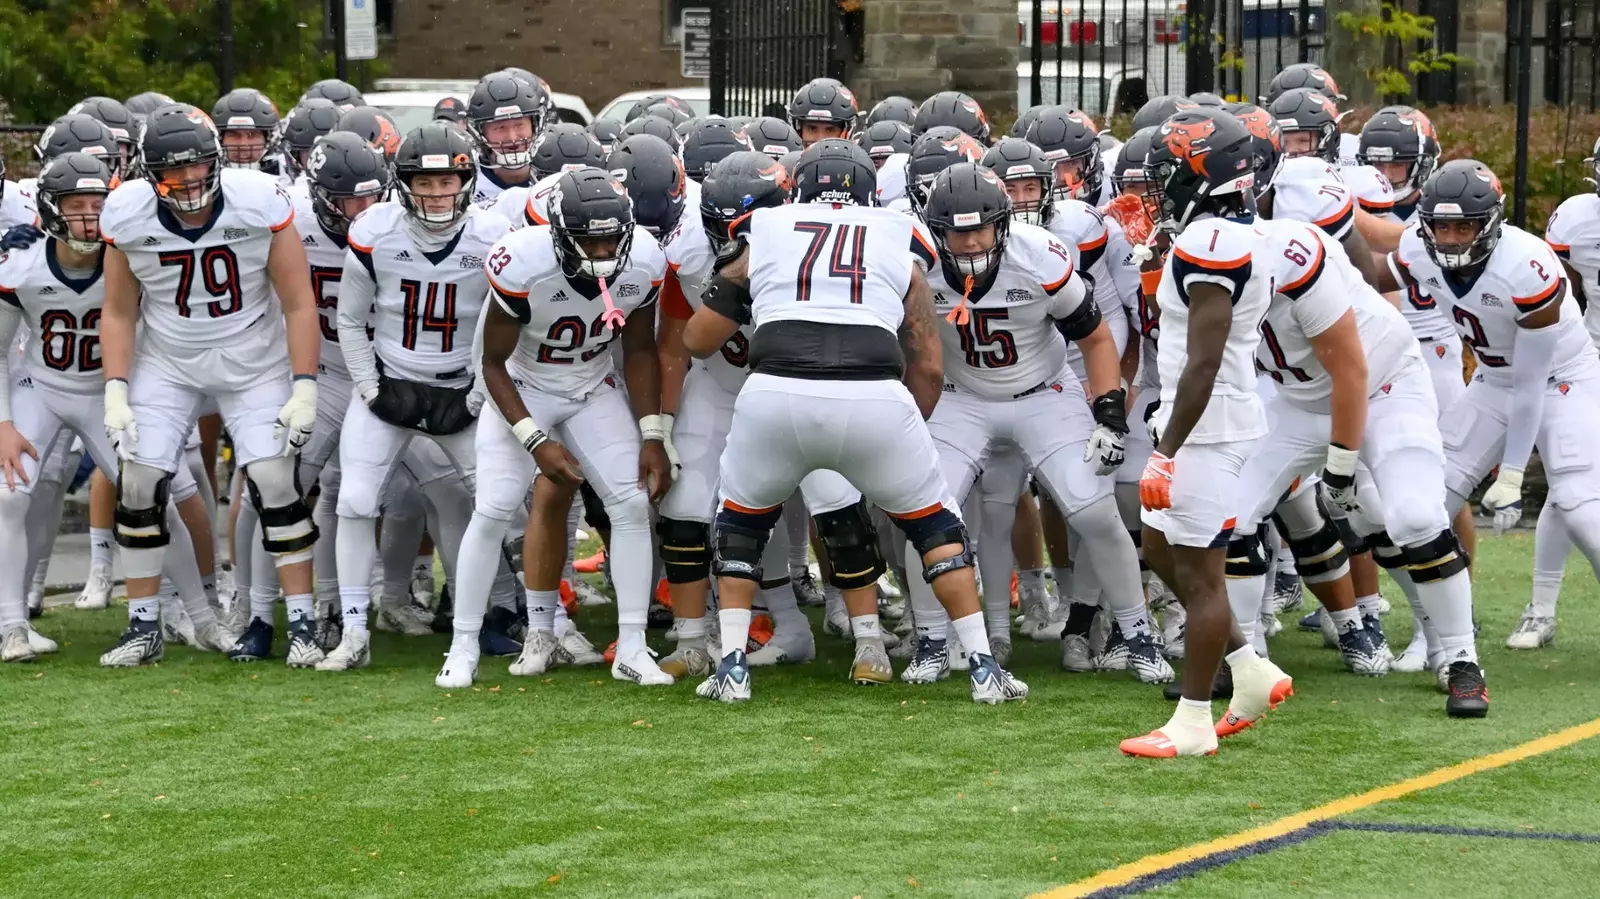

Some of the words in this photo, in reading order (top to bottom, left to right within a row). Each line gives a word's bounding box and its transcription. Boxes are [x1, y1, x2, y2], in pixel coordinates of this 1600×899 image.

[820, 188, 852, 200] schutt
[487, 245, 513, 277] 23
[1047, 237, 1069, 263] 15
[1208, 228, 1221, 253] 1
[1282, 237, 1313, 268] 67
[157, 243, 244, 318] 79
[793, 220, 869, 305] 74
[1529, 259, 1550, 282] 2
[400, 278, 460, 354] 14
[955, 306, 1020, 369] 15
[1452, 303, 1512, 368] 2
[536, 311, 622, 365] 23
